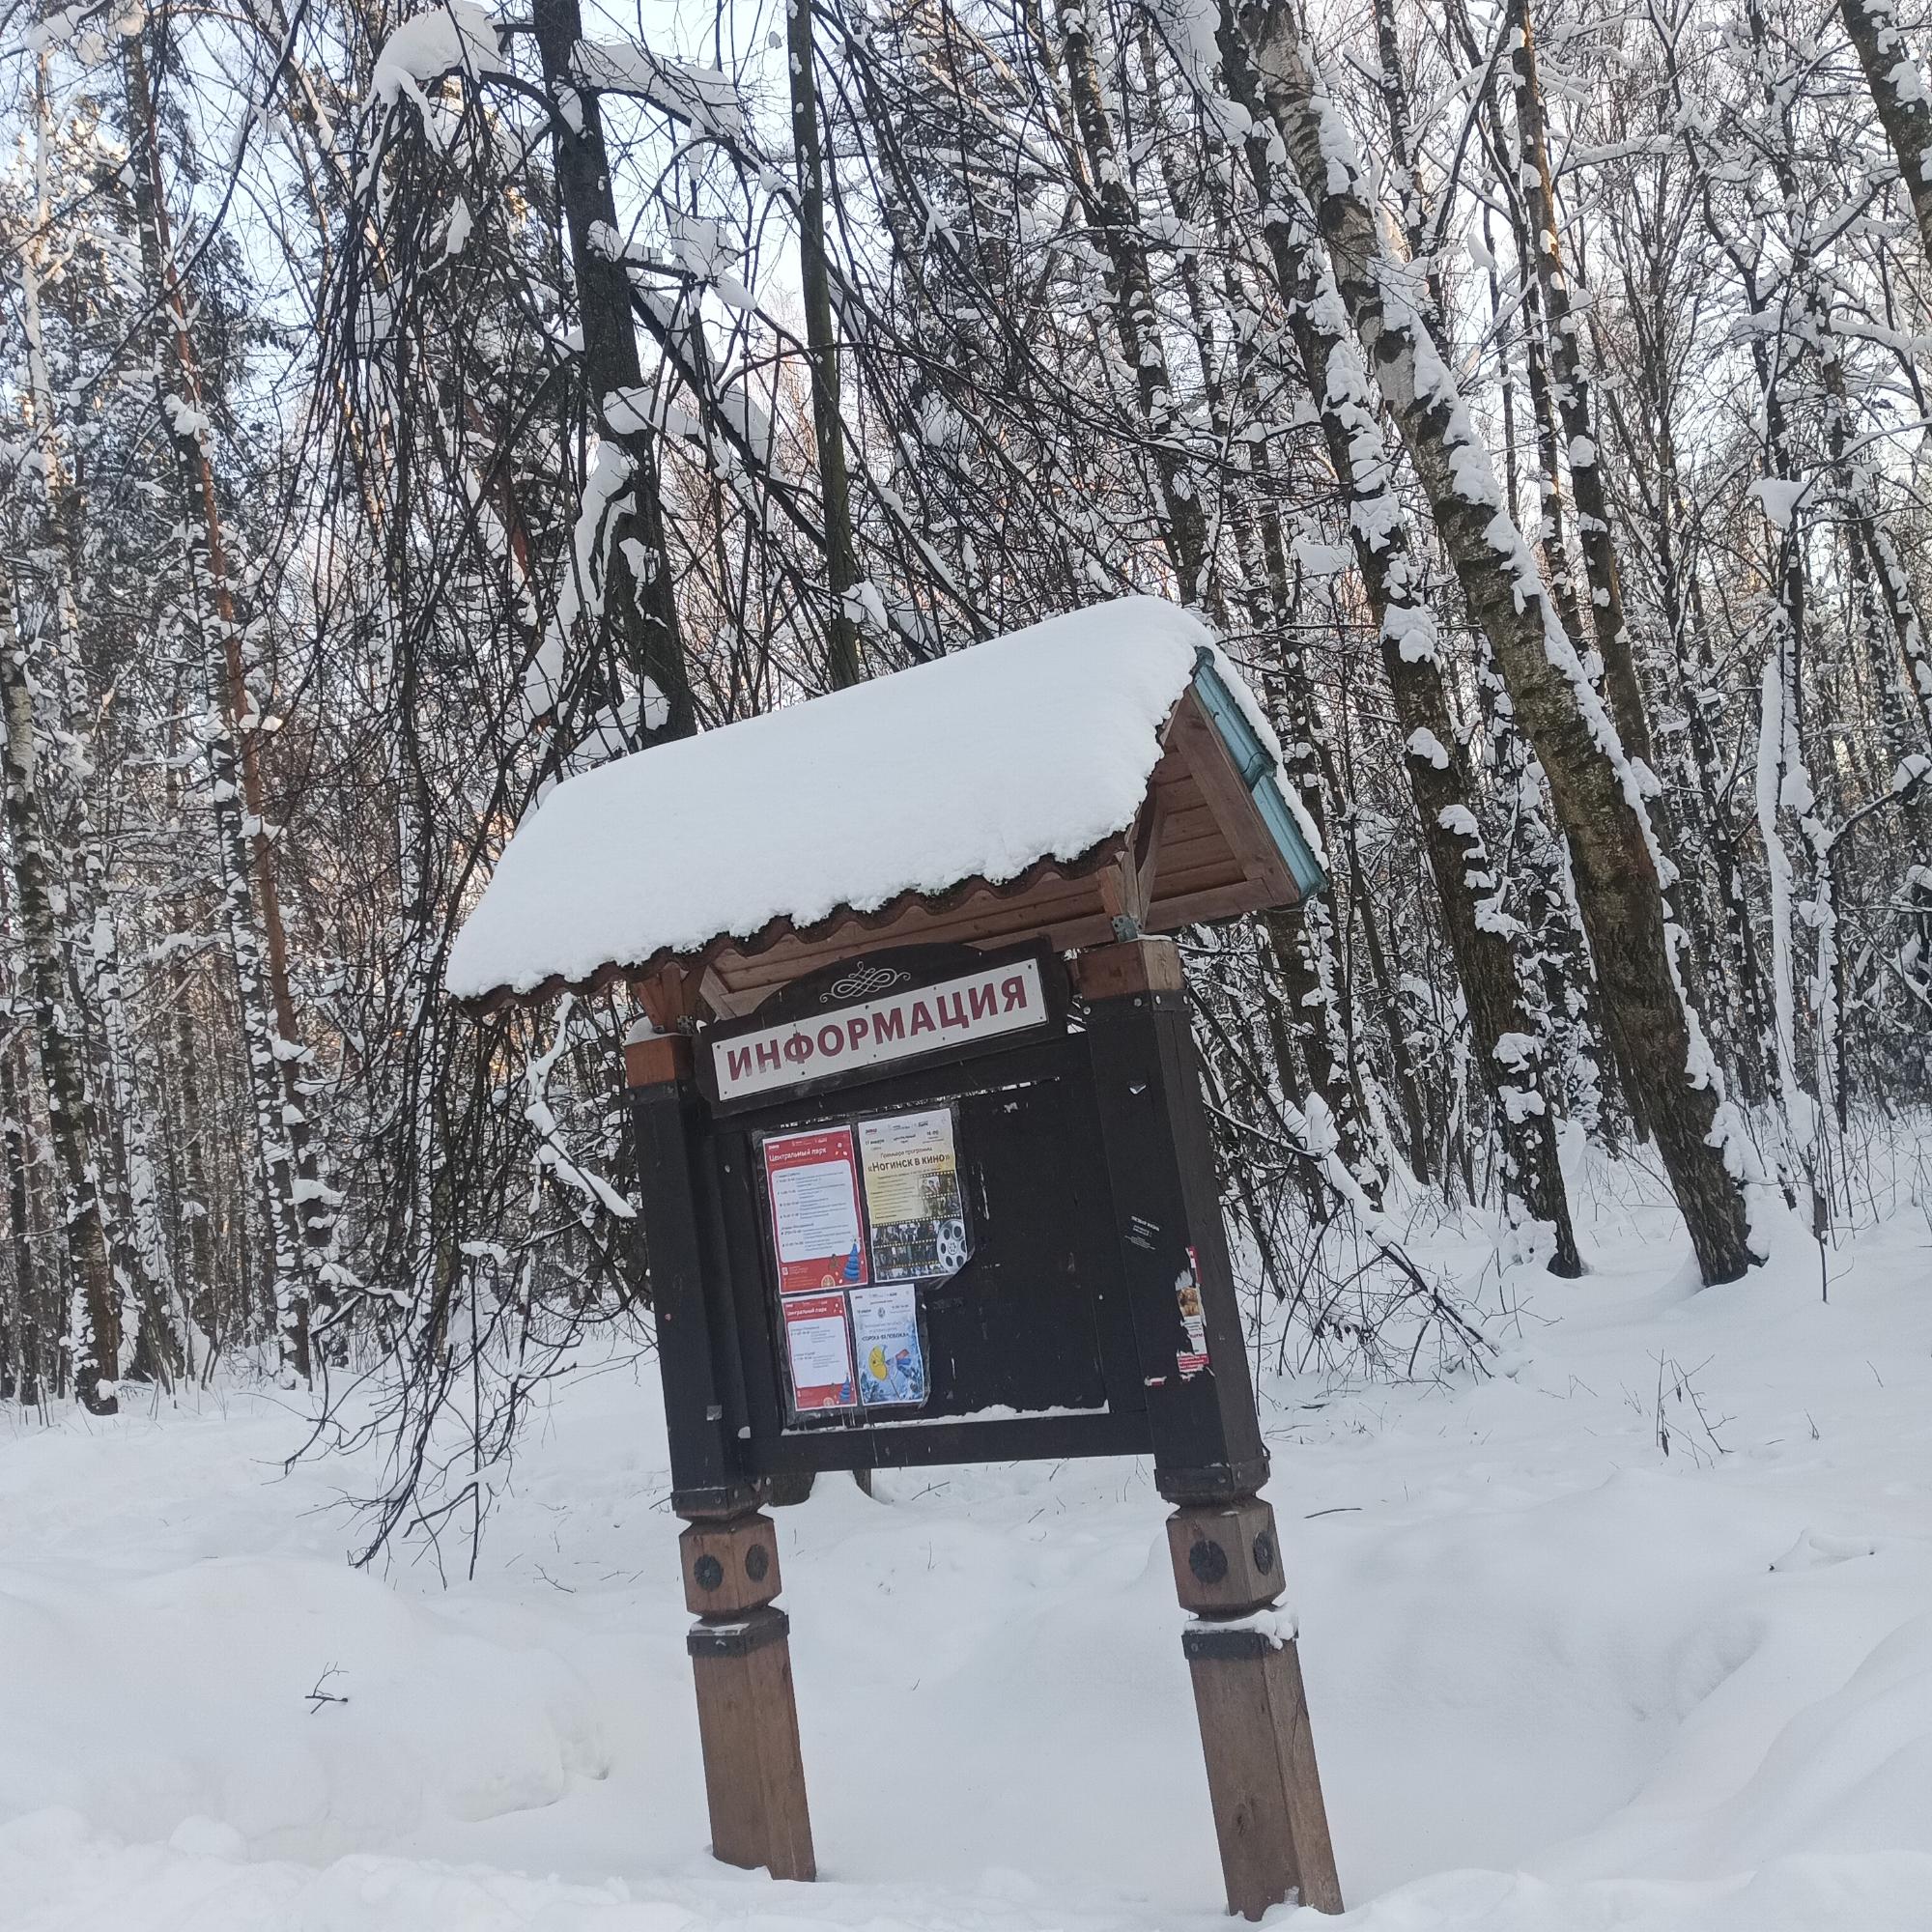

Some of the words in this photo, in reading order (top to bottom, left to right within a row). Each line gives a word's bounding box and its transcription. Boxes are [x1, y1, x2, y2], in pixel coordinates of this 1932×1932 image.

[727, 975, 1028, 1082] ИНФОРМАЦИЯ
[769, 1149, 810, 1162] Центральный
[811, 1147, 827, 1156] парк
[867, 1159, 913, 1173] «Ногинск
[922, 1153, 951, 1164] кино»
